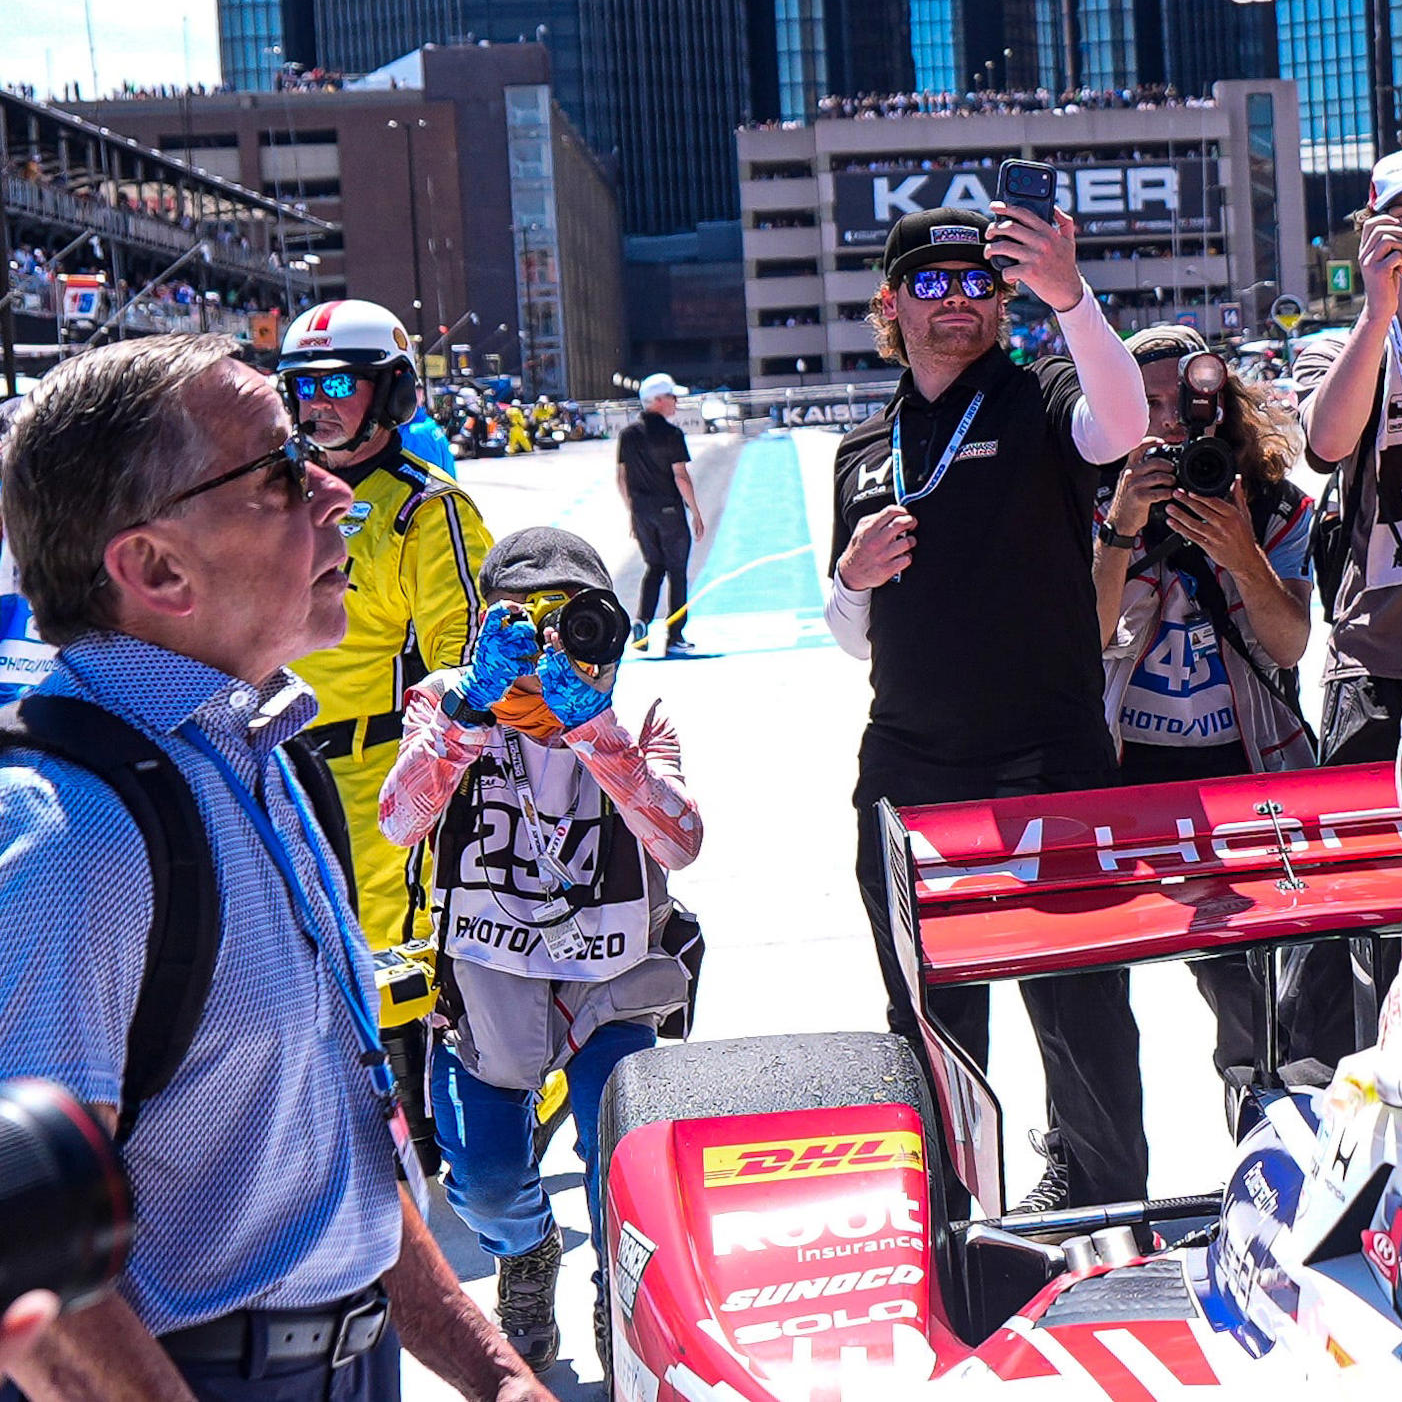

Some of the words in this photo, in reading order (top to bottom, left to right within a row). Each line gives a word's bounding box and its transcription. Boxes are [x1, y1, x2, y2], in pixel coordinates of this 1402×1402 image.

[873, 166, 1178, 221] KAER
[454, 915, 626, 961] PHOTO/DEO
[736, 1139, 898, 1178] DHL
[711, 1190, 924, 1257] Root
[720, 1264, 925, 1312] SUNOCO
[735, 1299, 919, 1346] SOLO
